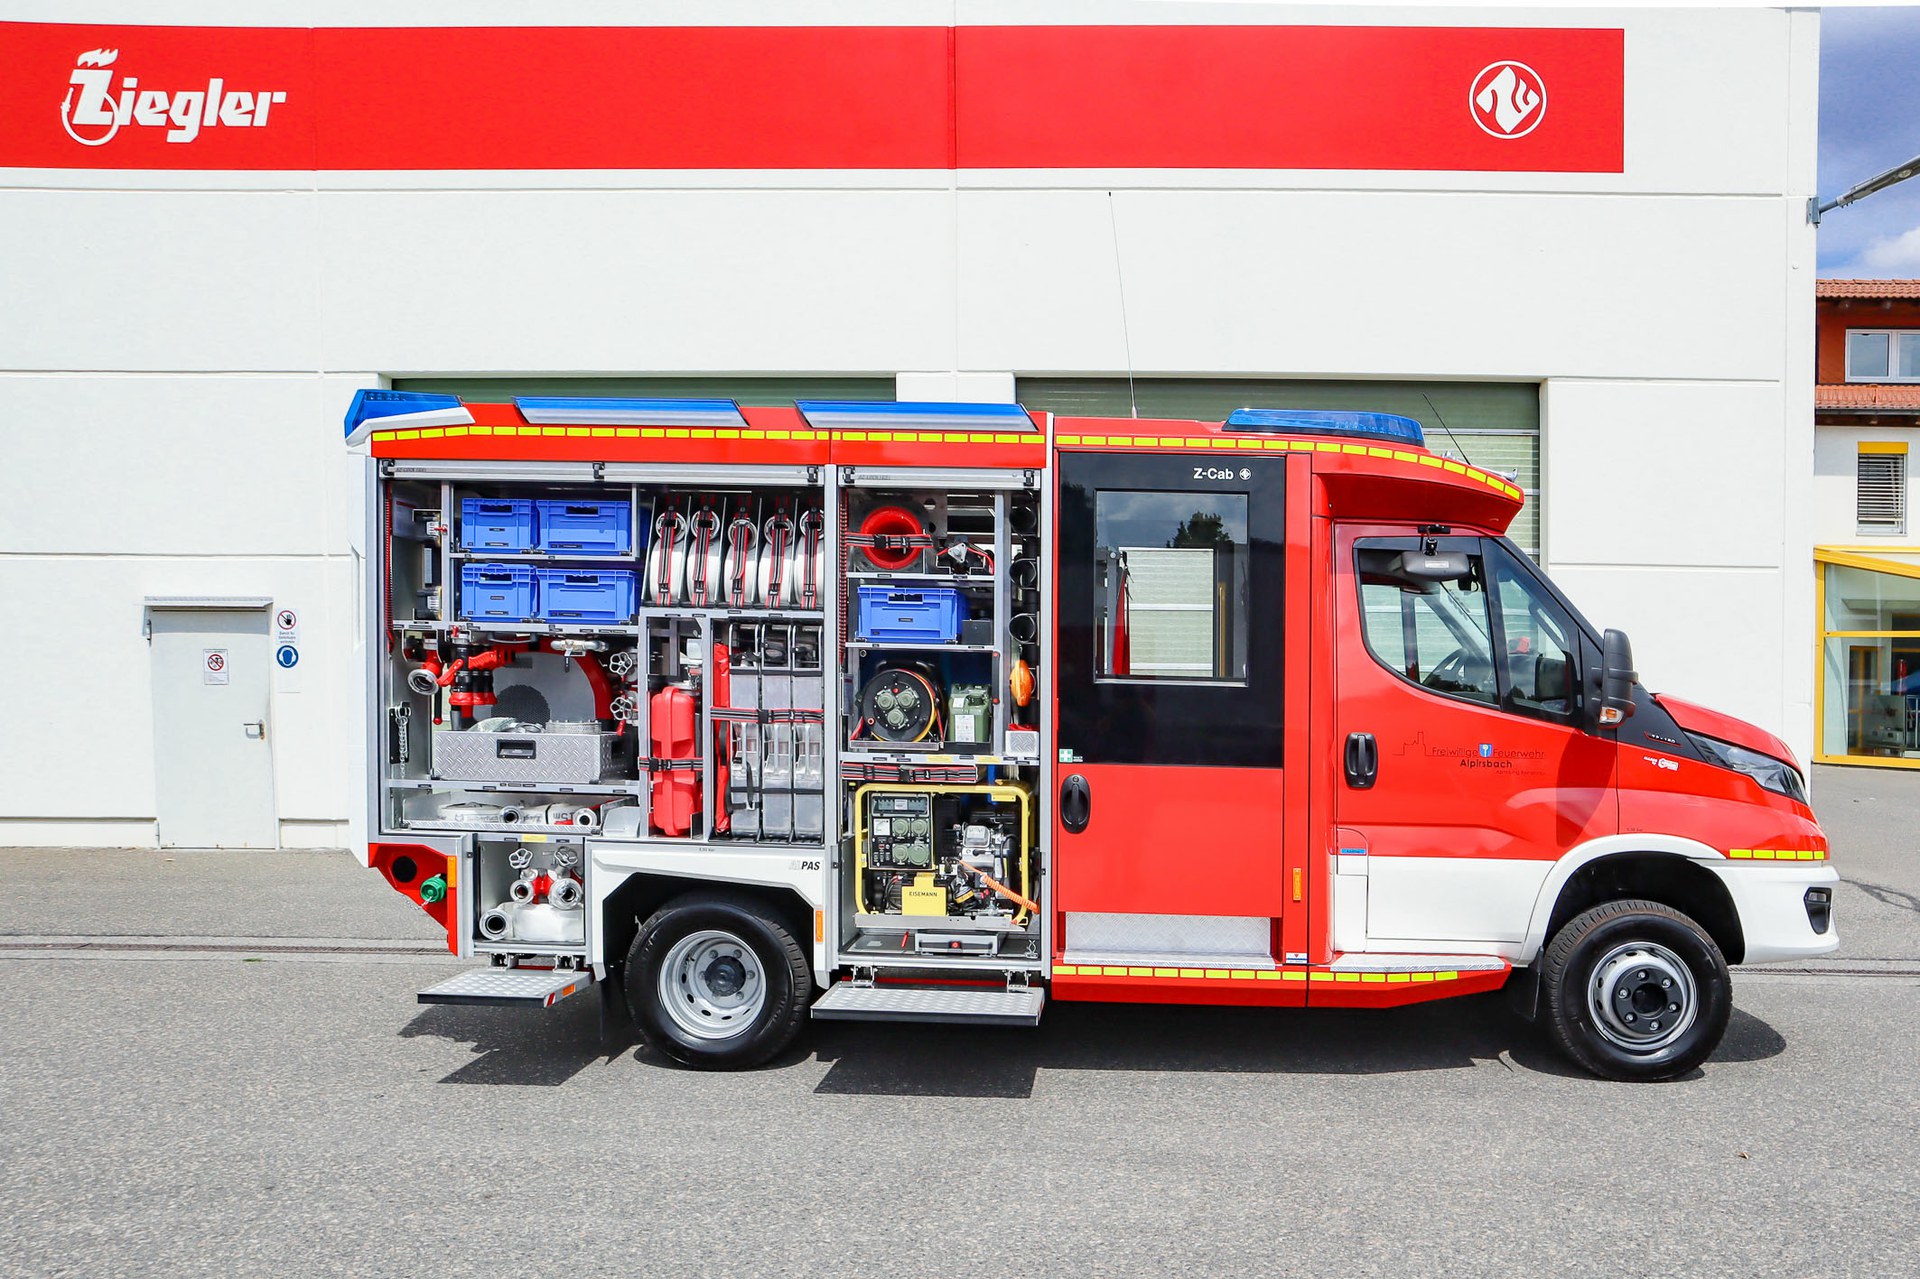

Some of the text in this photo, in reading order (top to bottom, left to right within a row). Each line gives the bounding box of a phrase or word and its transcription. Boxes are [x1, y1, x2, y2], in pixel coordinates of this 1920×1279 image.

[60, 68, 287, 146] Ziegler
[1193, 467, 1234, 480] Z-Cab
[1493, 748, 1545, 758] Feuerwehr
[1460, 759, 1513, 769] Alpirsbach
